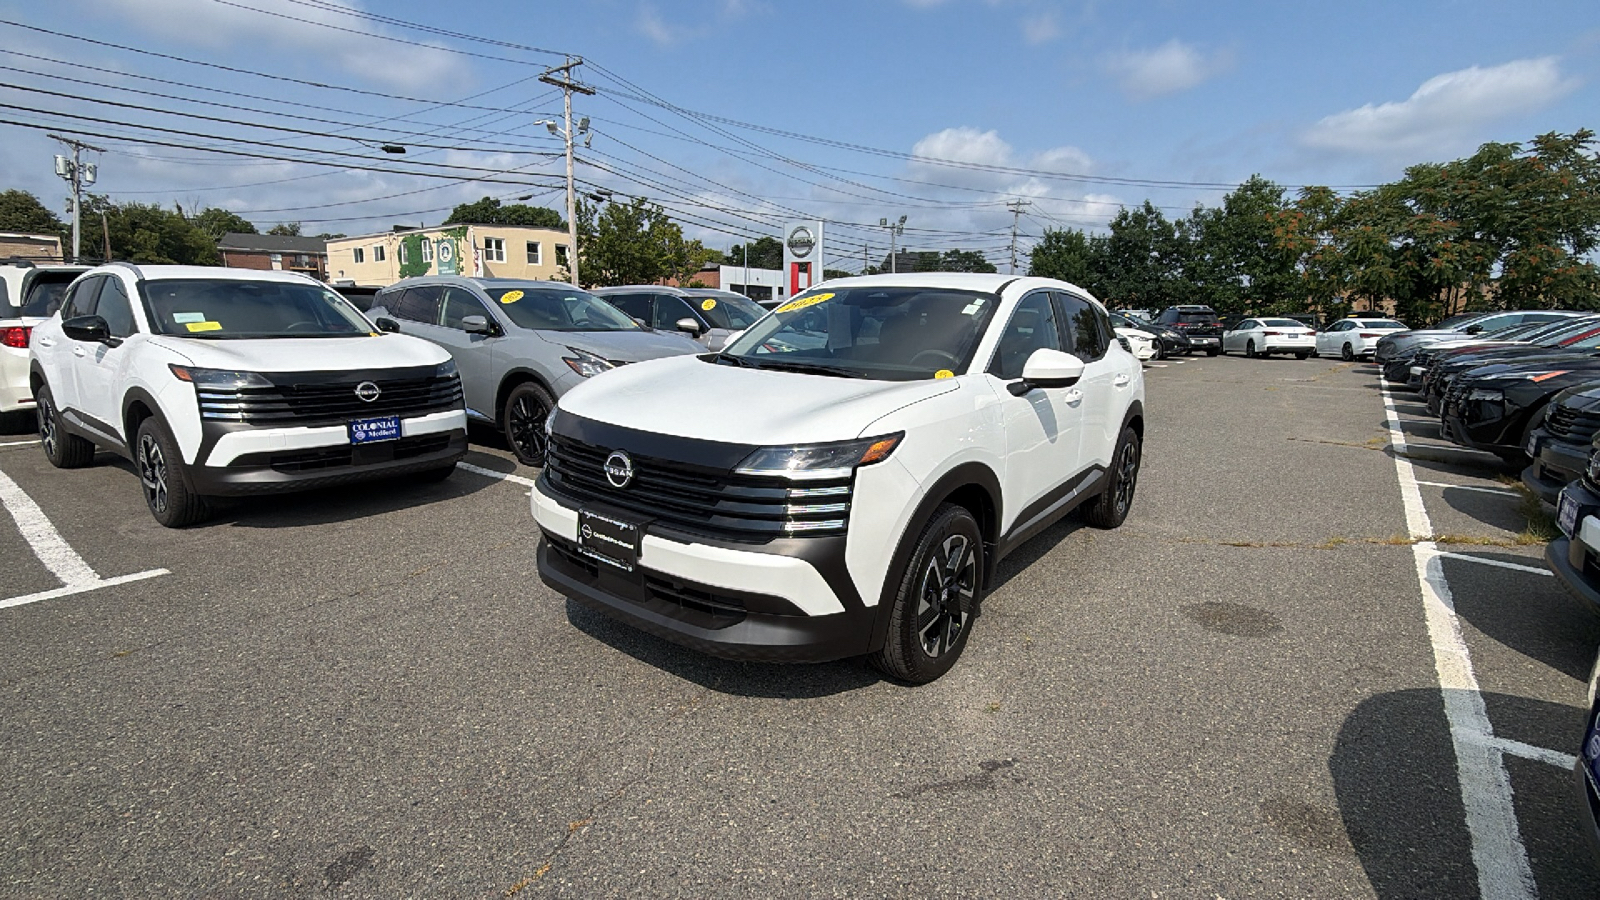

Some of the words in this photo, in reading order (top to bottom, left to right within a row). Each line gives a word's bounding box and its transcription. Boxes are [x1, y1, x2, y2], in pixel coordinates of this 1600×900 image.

[788, 237, 813, 246] NISSAN
[352, 421, 398, 431] COLONIAL
[368, 429, 396, 437] Medford
